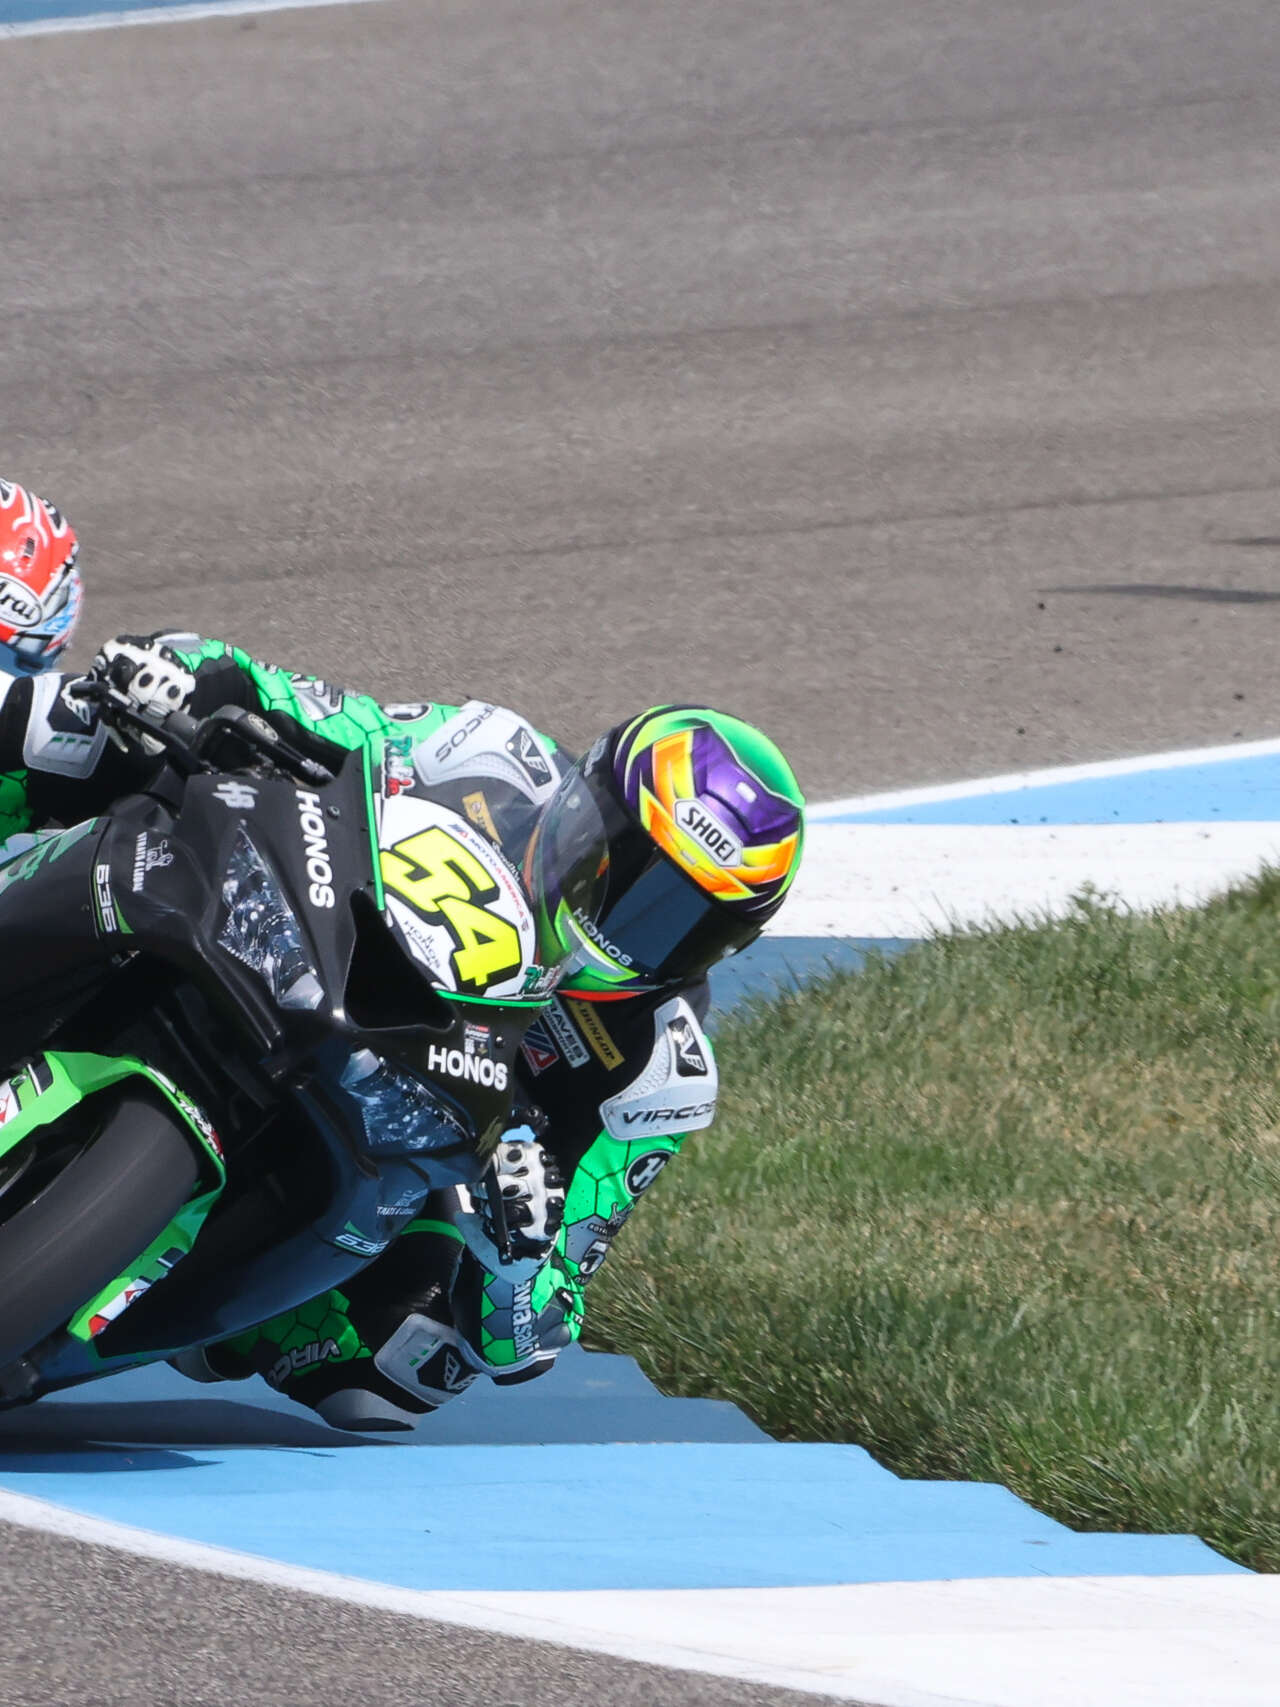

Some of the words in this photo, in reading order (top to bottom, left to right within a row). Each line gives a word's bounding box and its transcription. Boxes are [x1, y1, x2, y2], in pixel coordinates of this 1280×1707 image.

[435, 704, 499, 763] RCOS
[296, 790, 334, 908] HONOS
[681, 807, 736, 862] SHOEI
[96, 864, 118, 933] 636
[380, 826, 521, 986] 54
[571, 907, 634, 967] HONOS
[576, 1006, 616, 1061] DUNLOP
[428, 1046, 508, 1092] HONOS
[624, 1100, 716, 1124] VIRCO
[513, 1280, 540, 1357] awasaki
